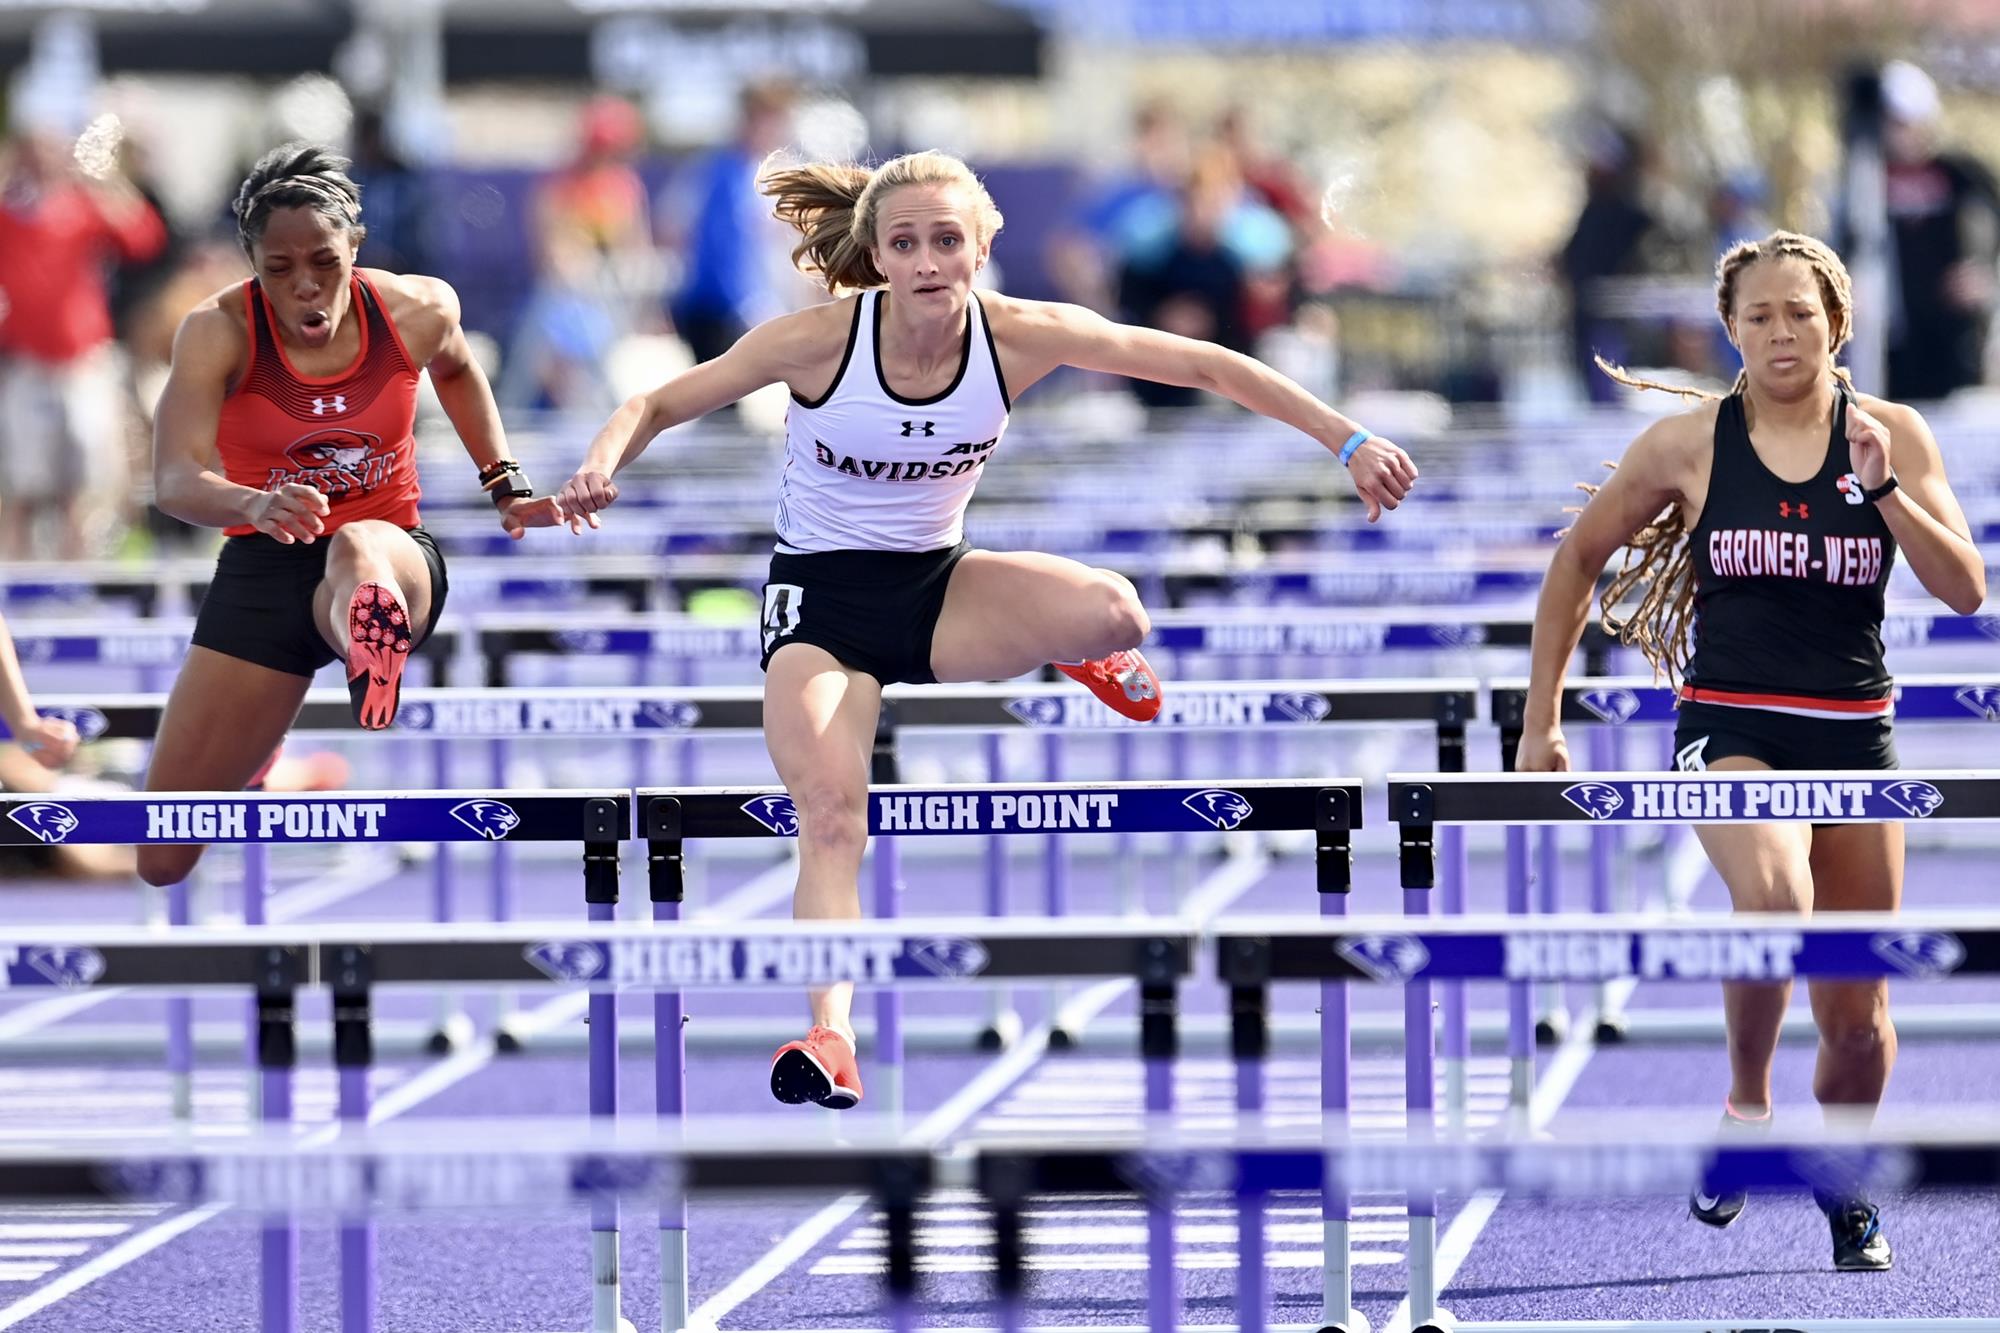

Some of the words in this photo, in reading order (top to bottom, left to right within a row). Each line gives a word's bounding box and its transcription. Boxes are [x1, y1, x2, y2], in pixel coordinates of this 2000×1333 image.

[942, 437, 998, 455] A10
[1709, 529, 1882, 586] GARDNER-WEBB
[763, 589, 789, 637] 4
[433, 701, 523, 732] HIGH
[528, 701, 640, 732] POINT
[1160, 694, 1270, 726] POINT
[879, 796, 980, 830] HIGH
[991, 794, 1118, 829] POINT
[1631, 783, 1733, 818] HIGH
[1743, 782, 1873, 817] POINT
[146, 804, 247, 838] HIGH
[258, 803, 387, 838] POINT
[611, 938, 734, 984] HIGH
[745, 937, 903, 984] POINT
[1505, 932, 1631, 979] HIGH
[1640, 931, 1803, 979] POINT
